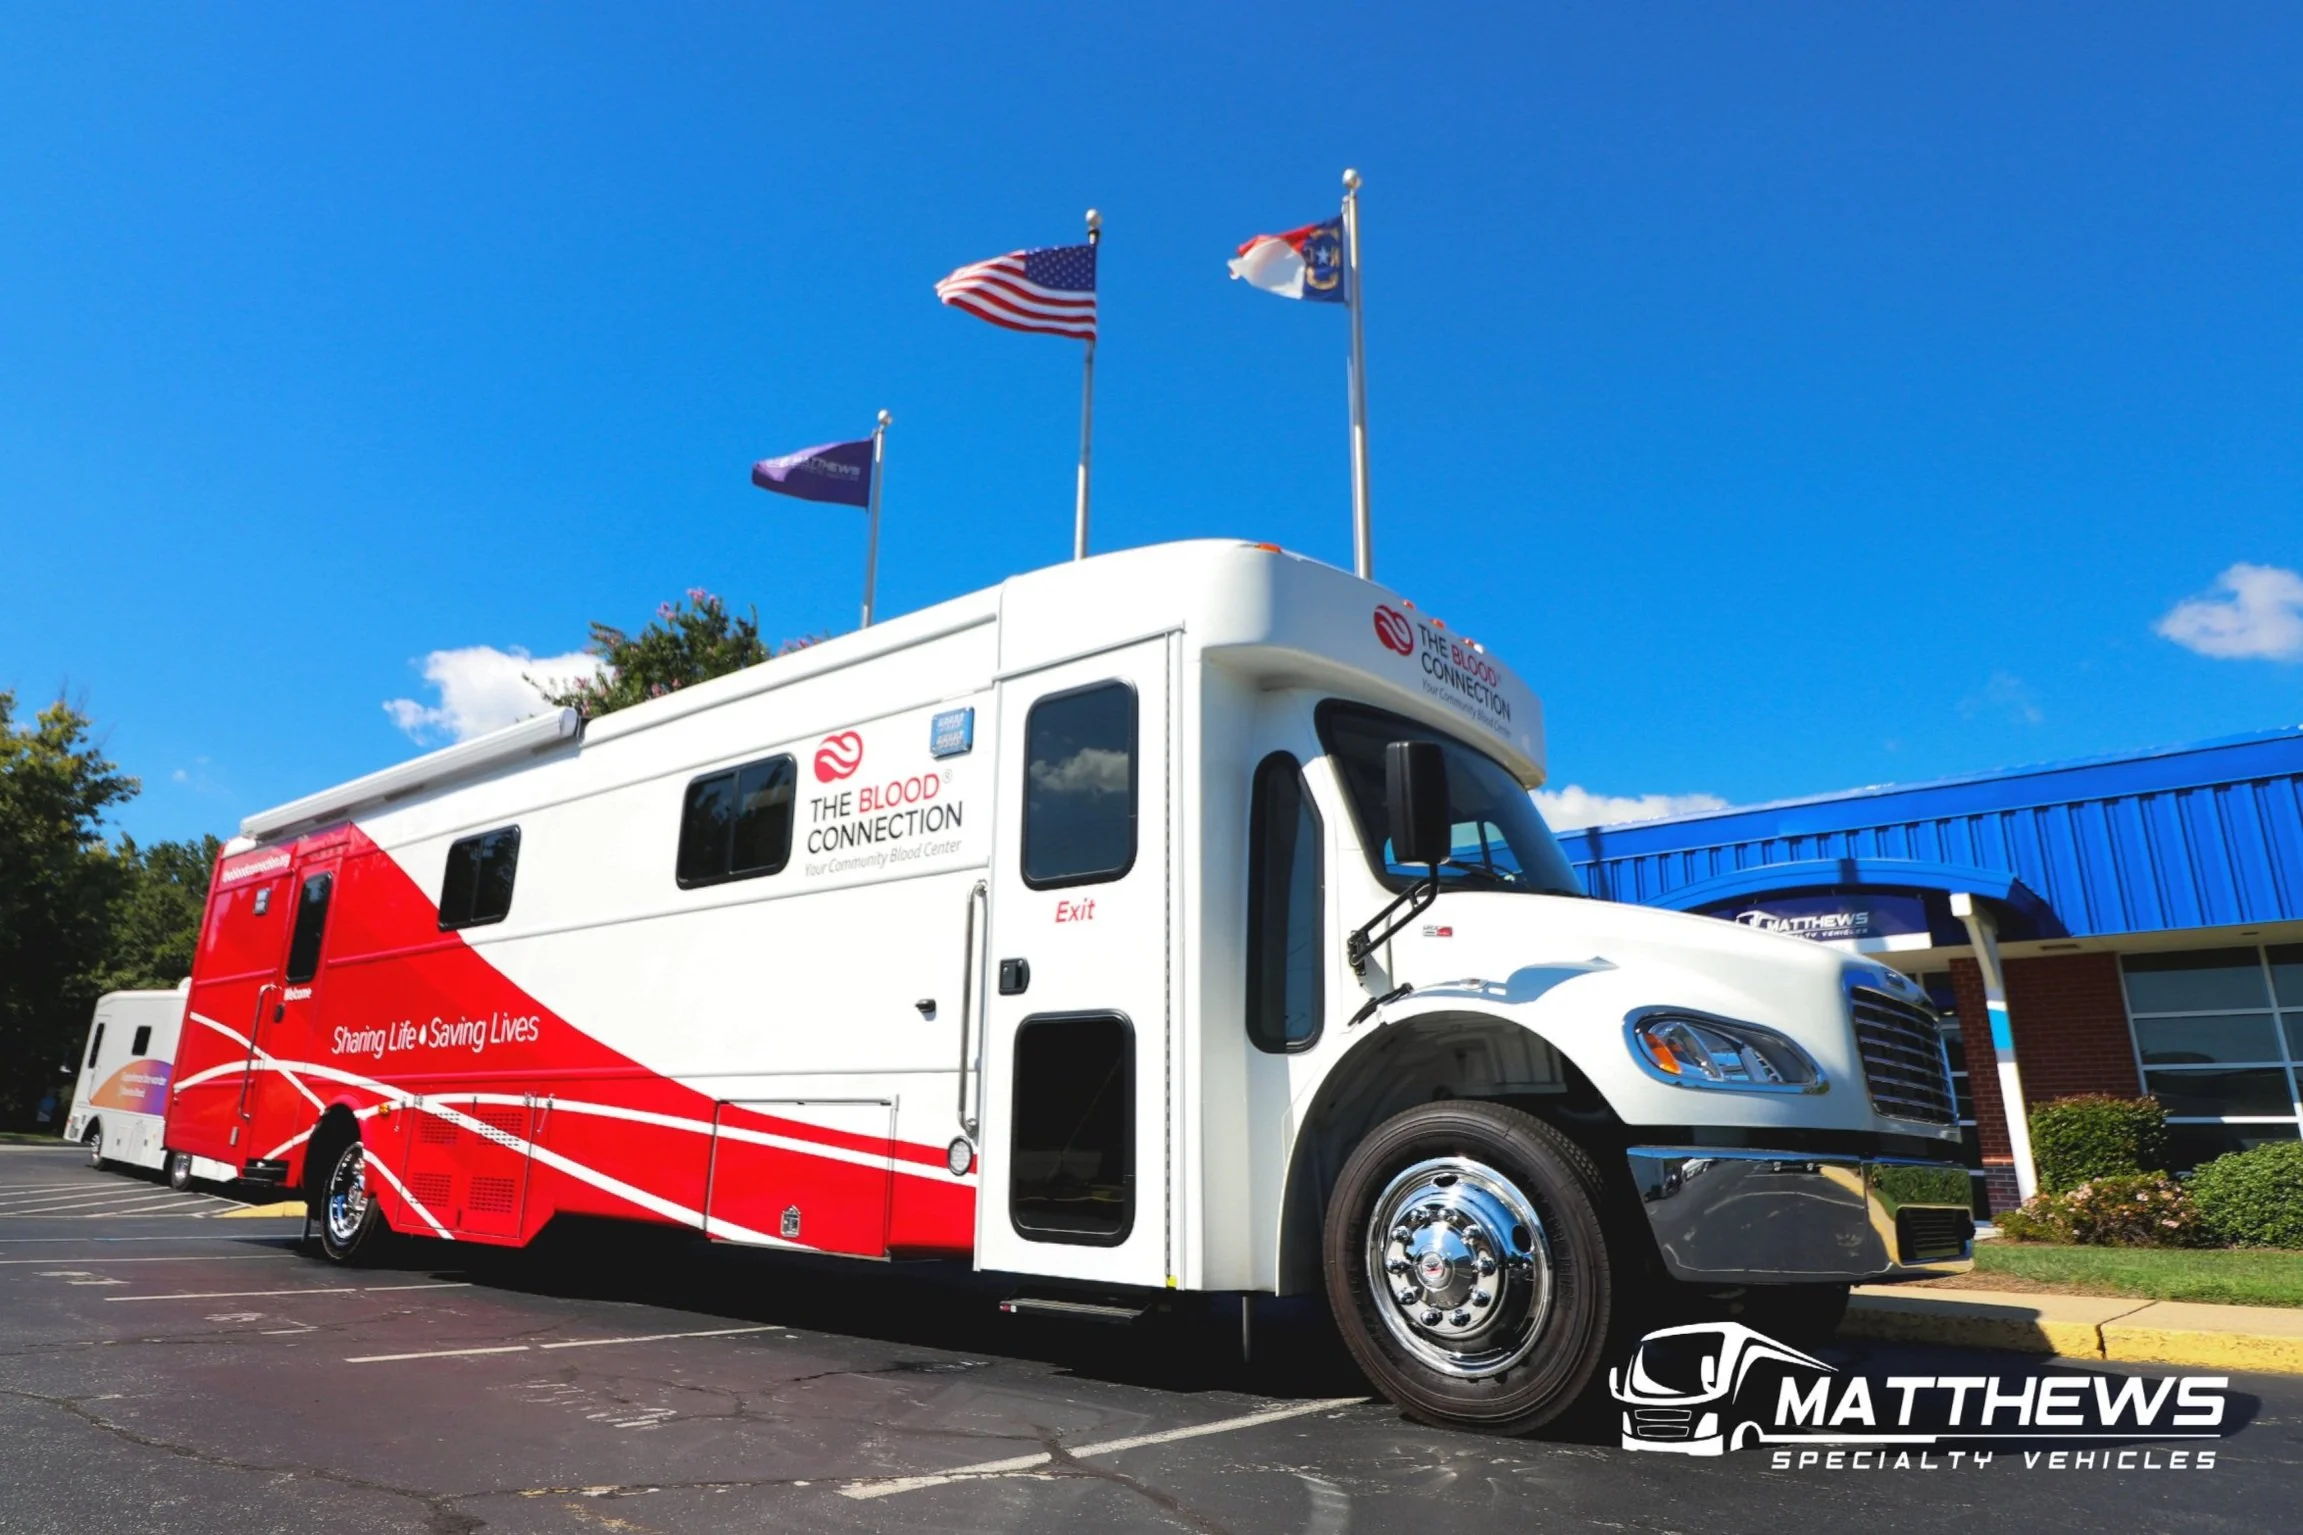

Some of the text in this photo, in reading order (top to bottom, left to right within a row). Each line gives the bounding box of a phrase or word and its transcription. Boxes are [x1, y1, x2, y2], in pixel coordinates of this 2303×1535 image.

[1418, 623, 1497, 688] THE BLOOD
[1421, 652, 1511, 722] CONNECTION
[811, 773, 940, 823] THE BLOOD
[807, 801, 963, 854] CONNECTION
[805, 840, 962, 877] Your Community Blood Center
[1055, 897, 1096, 923] Exit
[1766, 912, 1868, 932] MATTHEWS
[331, 1012, 540, 1059] Sharing Life Saving Lives
